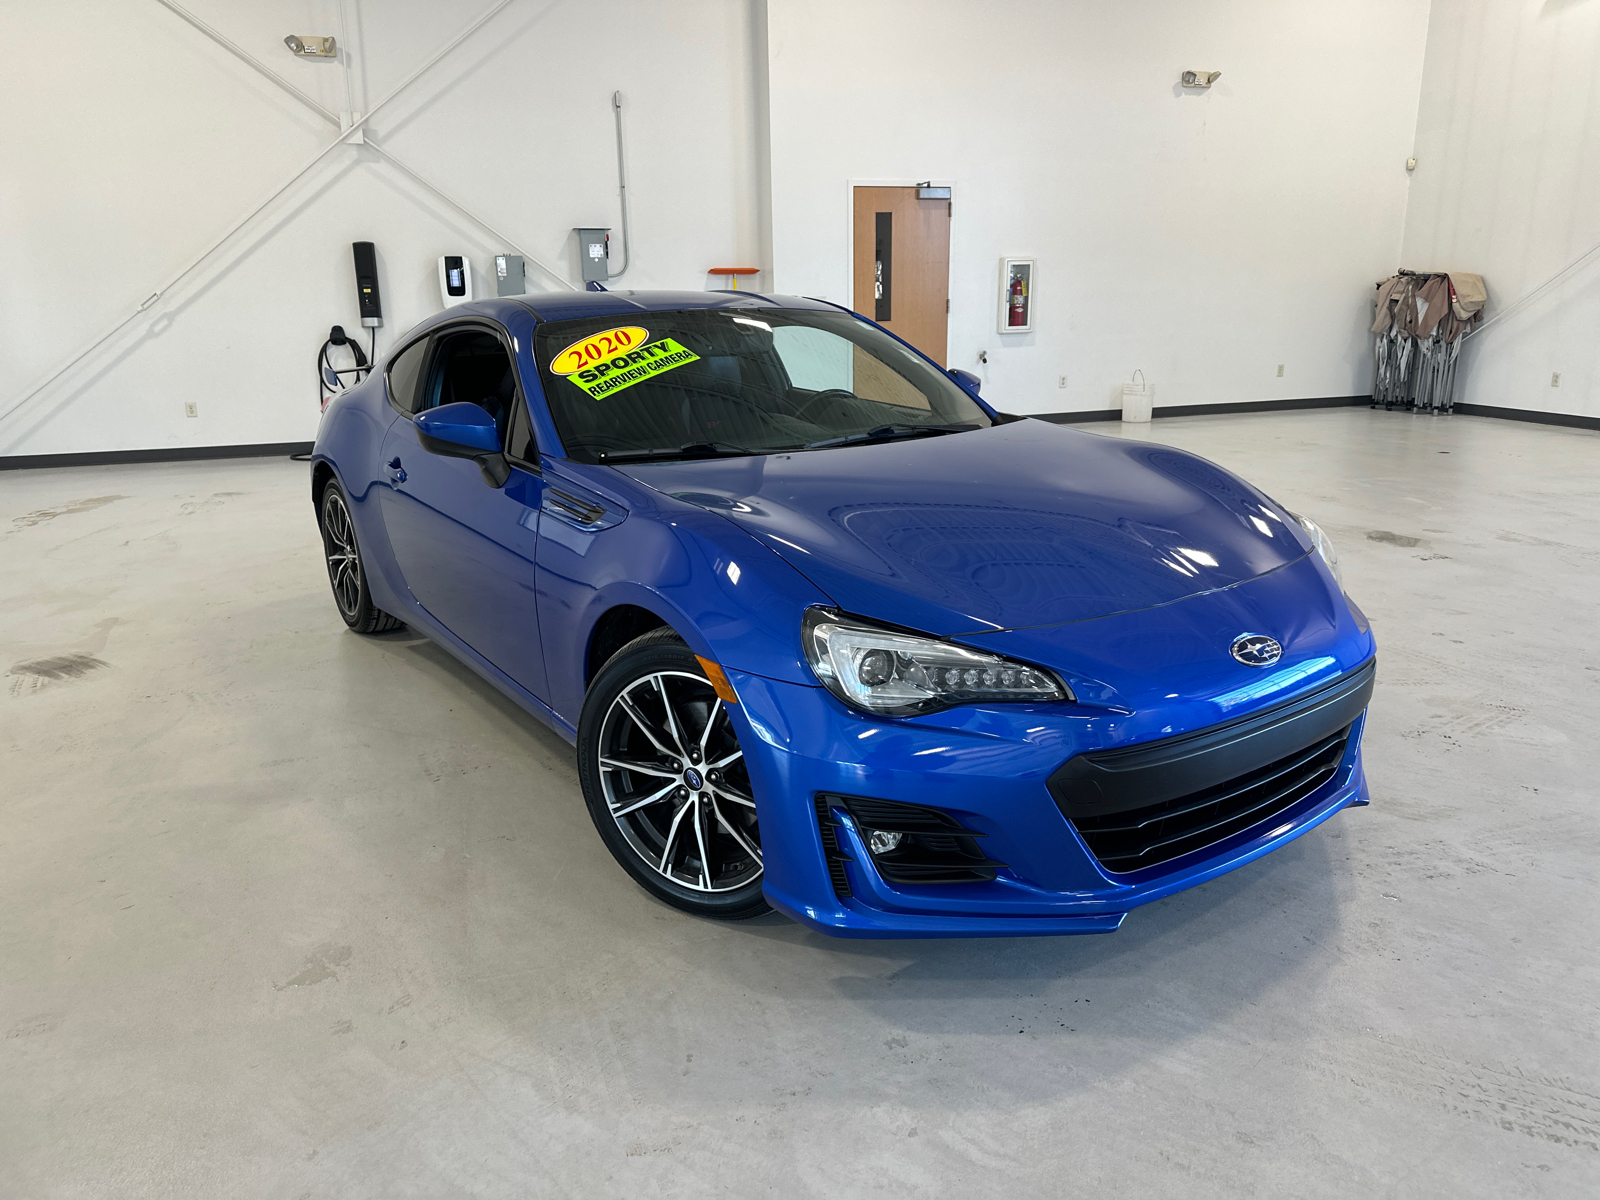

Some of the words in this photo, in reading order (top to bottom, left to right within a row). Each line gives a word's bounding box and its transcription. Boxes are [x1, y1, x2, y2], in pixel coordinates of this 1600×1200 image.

[569, 330, 632, 369] 2020
[578, 341, 670, 384] SPORTY
[587, 365, 650, 397] REARVIEW
[647, 349, 696, 371] CAMERA
